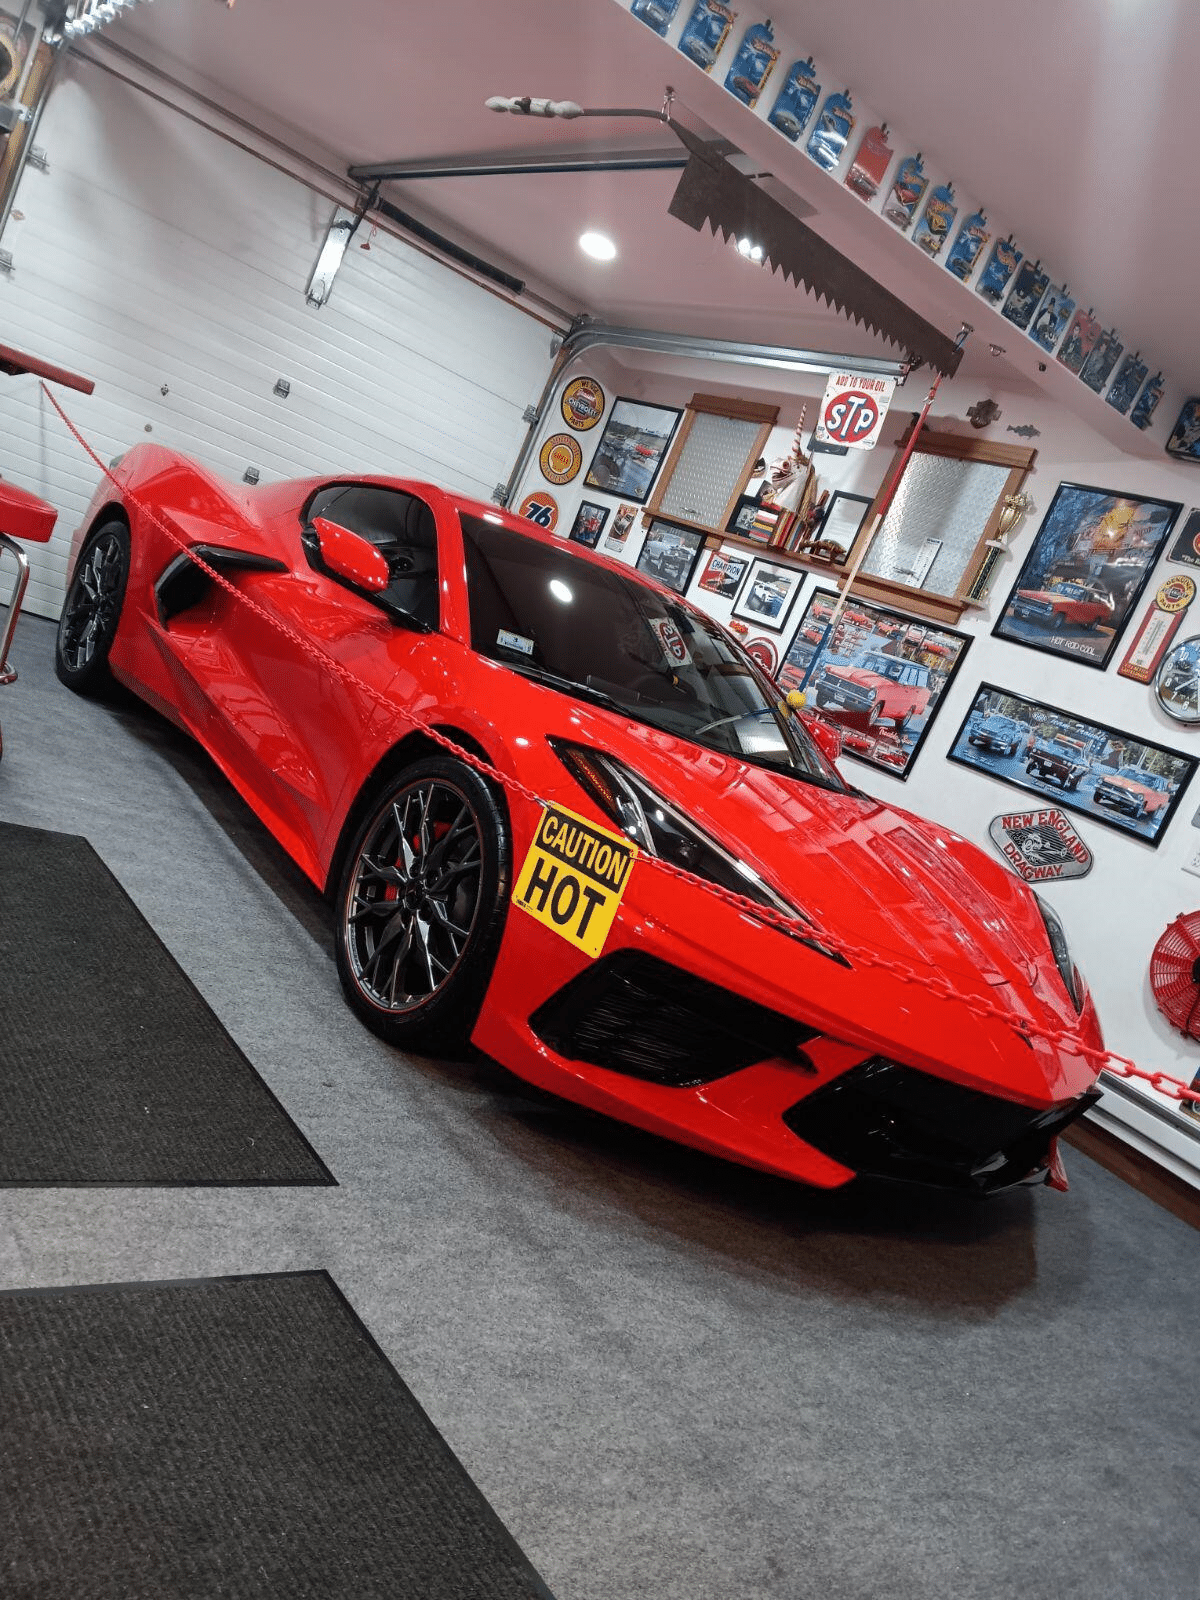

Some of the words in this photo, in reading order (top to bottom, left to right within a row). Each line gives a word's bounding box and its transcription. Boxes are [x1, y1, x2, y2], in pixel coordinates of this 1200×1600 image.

[836, 375, 849, 387] ADD
[849, 376, 859, 388] TO
[859, 378, 875, 391] YOUR
[875, 380, 886, 392] OIL
[569, 416, 585, 428] PARTS
[827, 395, 875, 439] STP
[525, 501, 554, 528] 76
[711, 559, 741, 575] CHAMPION
[1050, 636, 1065, 646] HOT
[1065, 640, 1080, 650] ROD
[1179, 646, 1190, 661] 10
[1166, 662, 1173, 672] 9
[1165, 677, 1173, 687] 8
[1182, 700, 1190, 710] 6
[1002, 813, 1034, 829] NEW
[1037, 811, 1089, 863] ENGLAND
[542, 816, 628, 885] CAUTION
[1003, 842, 1063, 880] DRAGWAY
[523, 856, 607, 940] HOT
